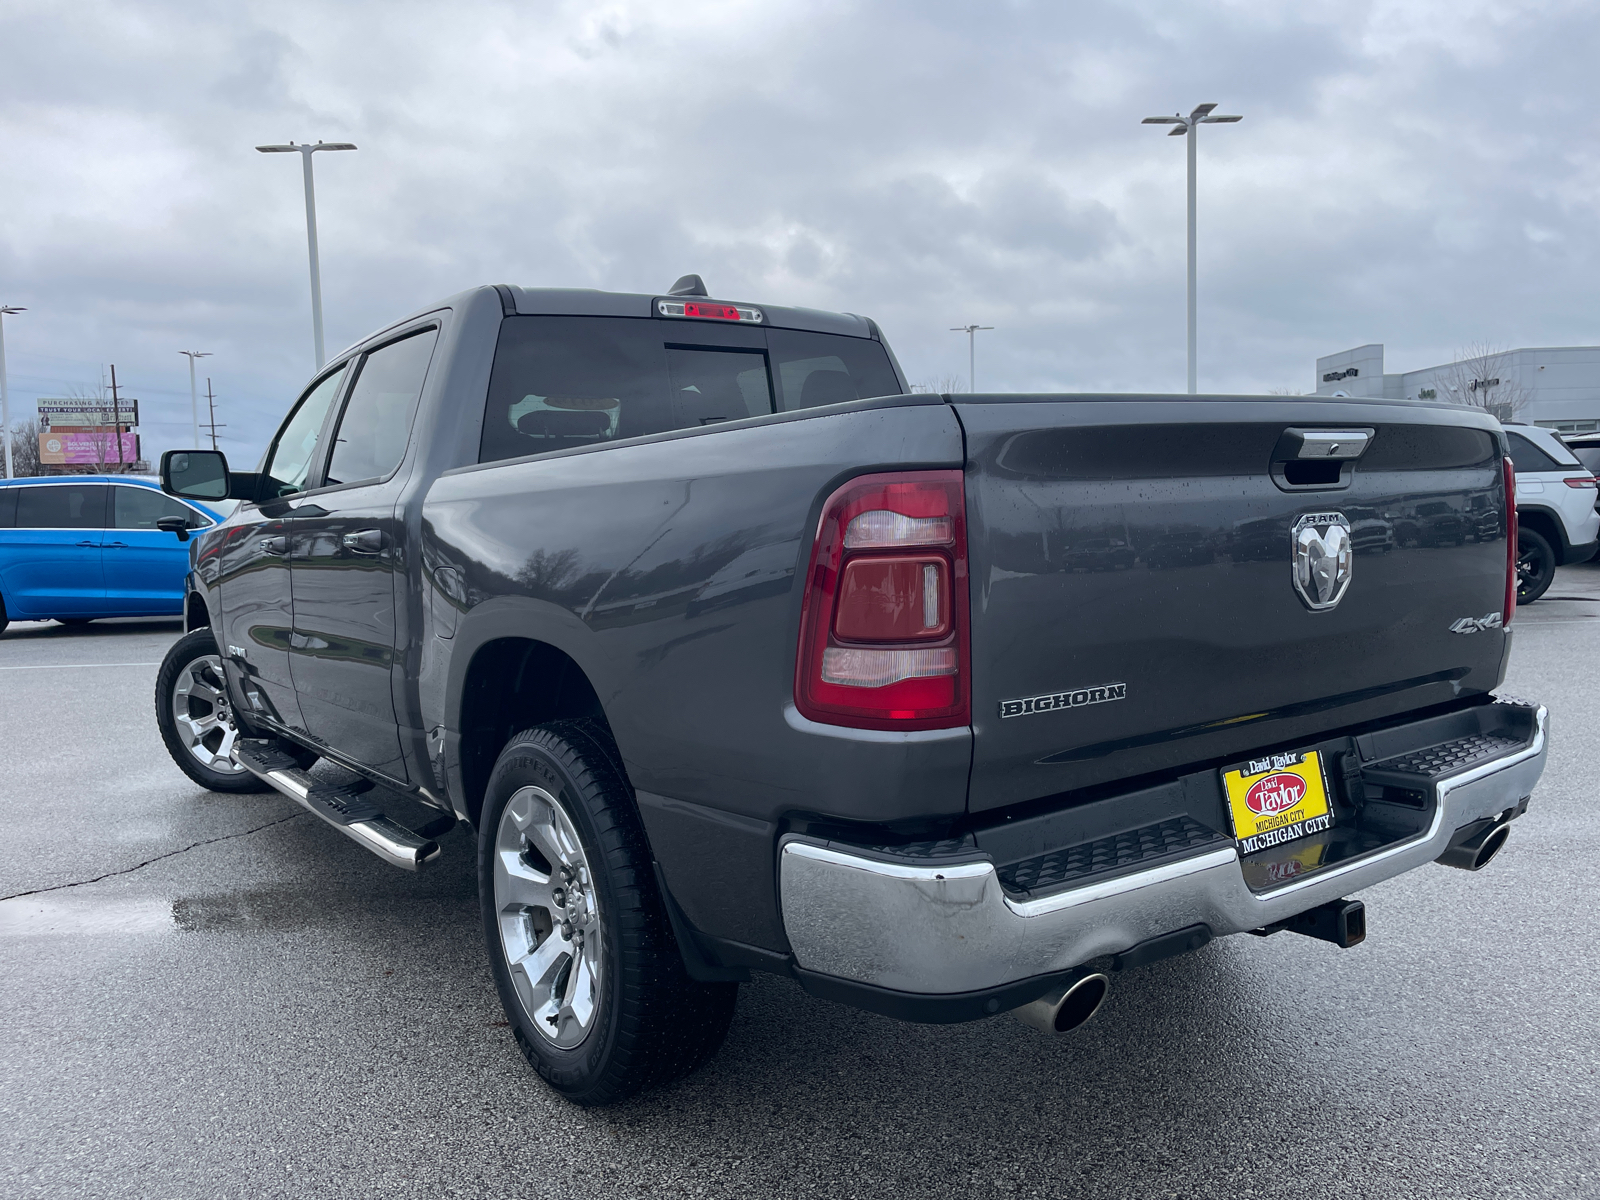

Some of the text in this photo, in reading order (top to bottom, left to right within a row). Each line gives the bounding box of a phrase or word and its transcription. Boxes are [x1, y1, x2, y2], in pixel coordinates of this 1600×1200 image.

[1305, 514, 1339, 523] RAM
[999, 682, 1126, 719] BIGHORN
[1248, 752, 1297, 774] David Taylor
[1260, 777, 1278, 791] David
[1255, 783, 1300, 814] Taylor
[1255, 809, 1305, 833] MICHIGAN CITY
[1241, 814, 1330, 854] MICHIGAN CITY
